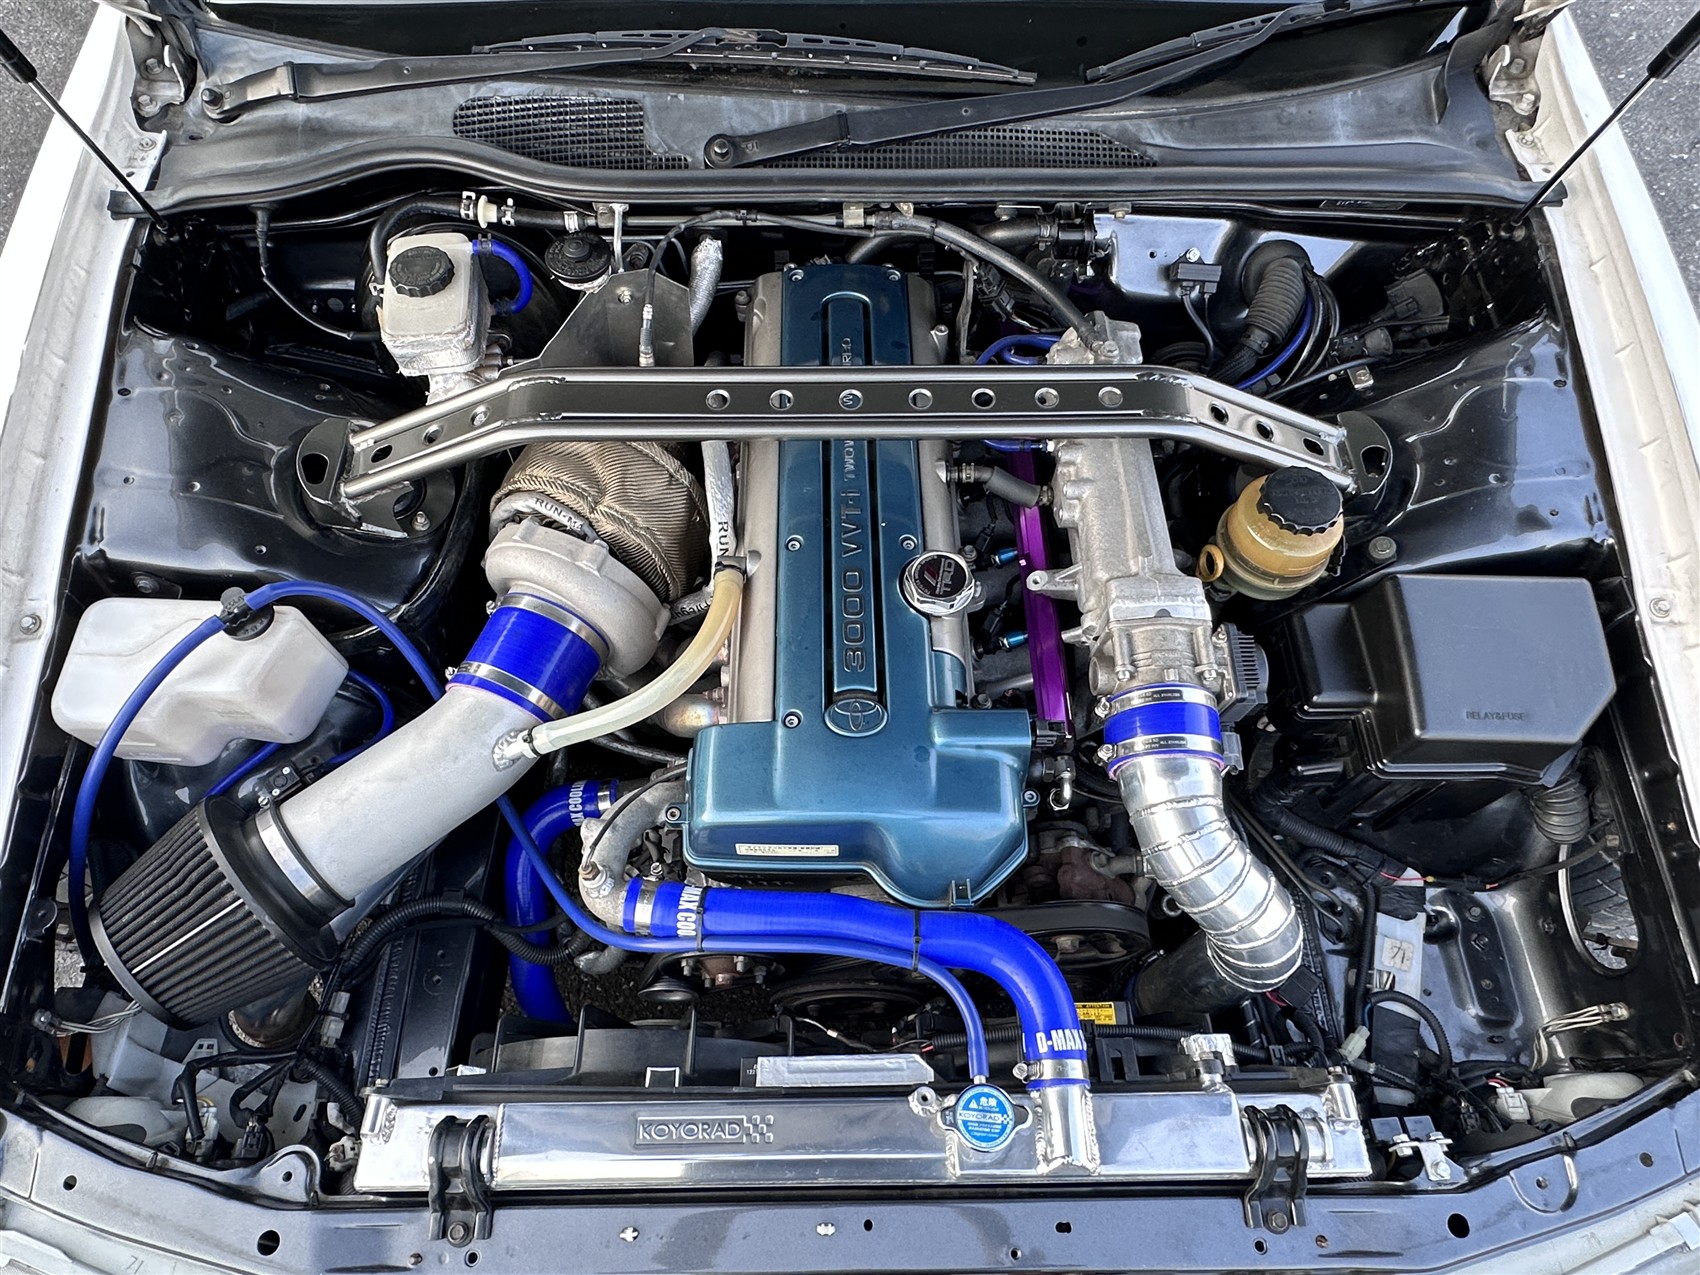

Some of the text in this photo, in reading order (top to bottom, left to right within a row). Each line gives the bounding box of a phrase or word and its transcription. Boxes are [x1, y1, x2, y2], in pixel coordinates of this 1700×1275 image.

[840, 489, 862, 557] VVT-i
[939, 559, 956, 595] TRD
[842, 569, 866, 672] 3000
[1465, 711, 1527, 721] RELAY&FUSE
[676, 885, 703, 937] MAX COO
[1035, 1029, 1082, 1053] D-MAX
[638, 1120, 742, 1141] KOYORAD
[958, 1111, 1000, 1122] KOYORAD
